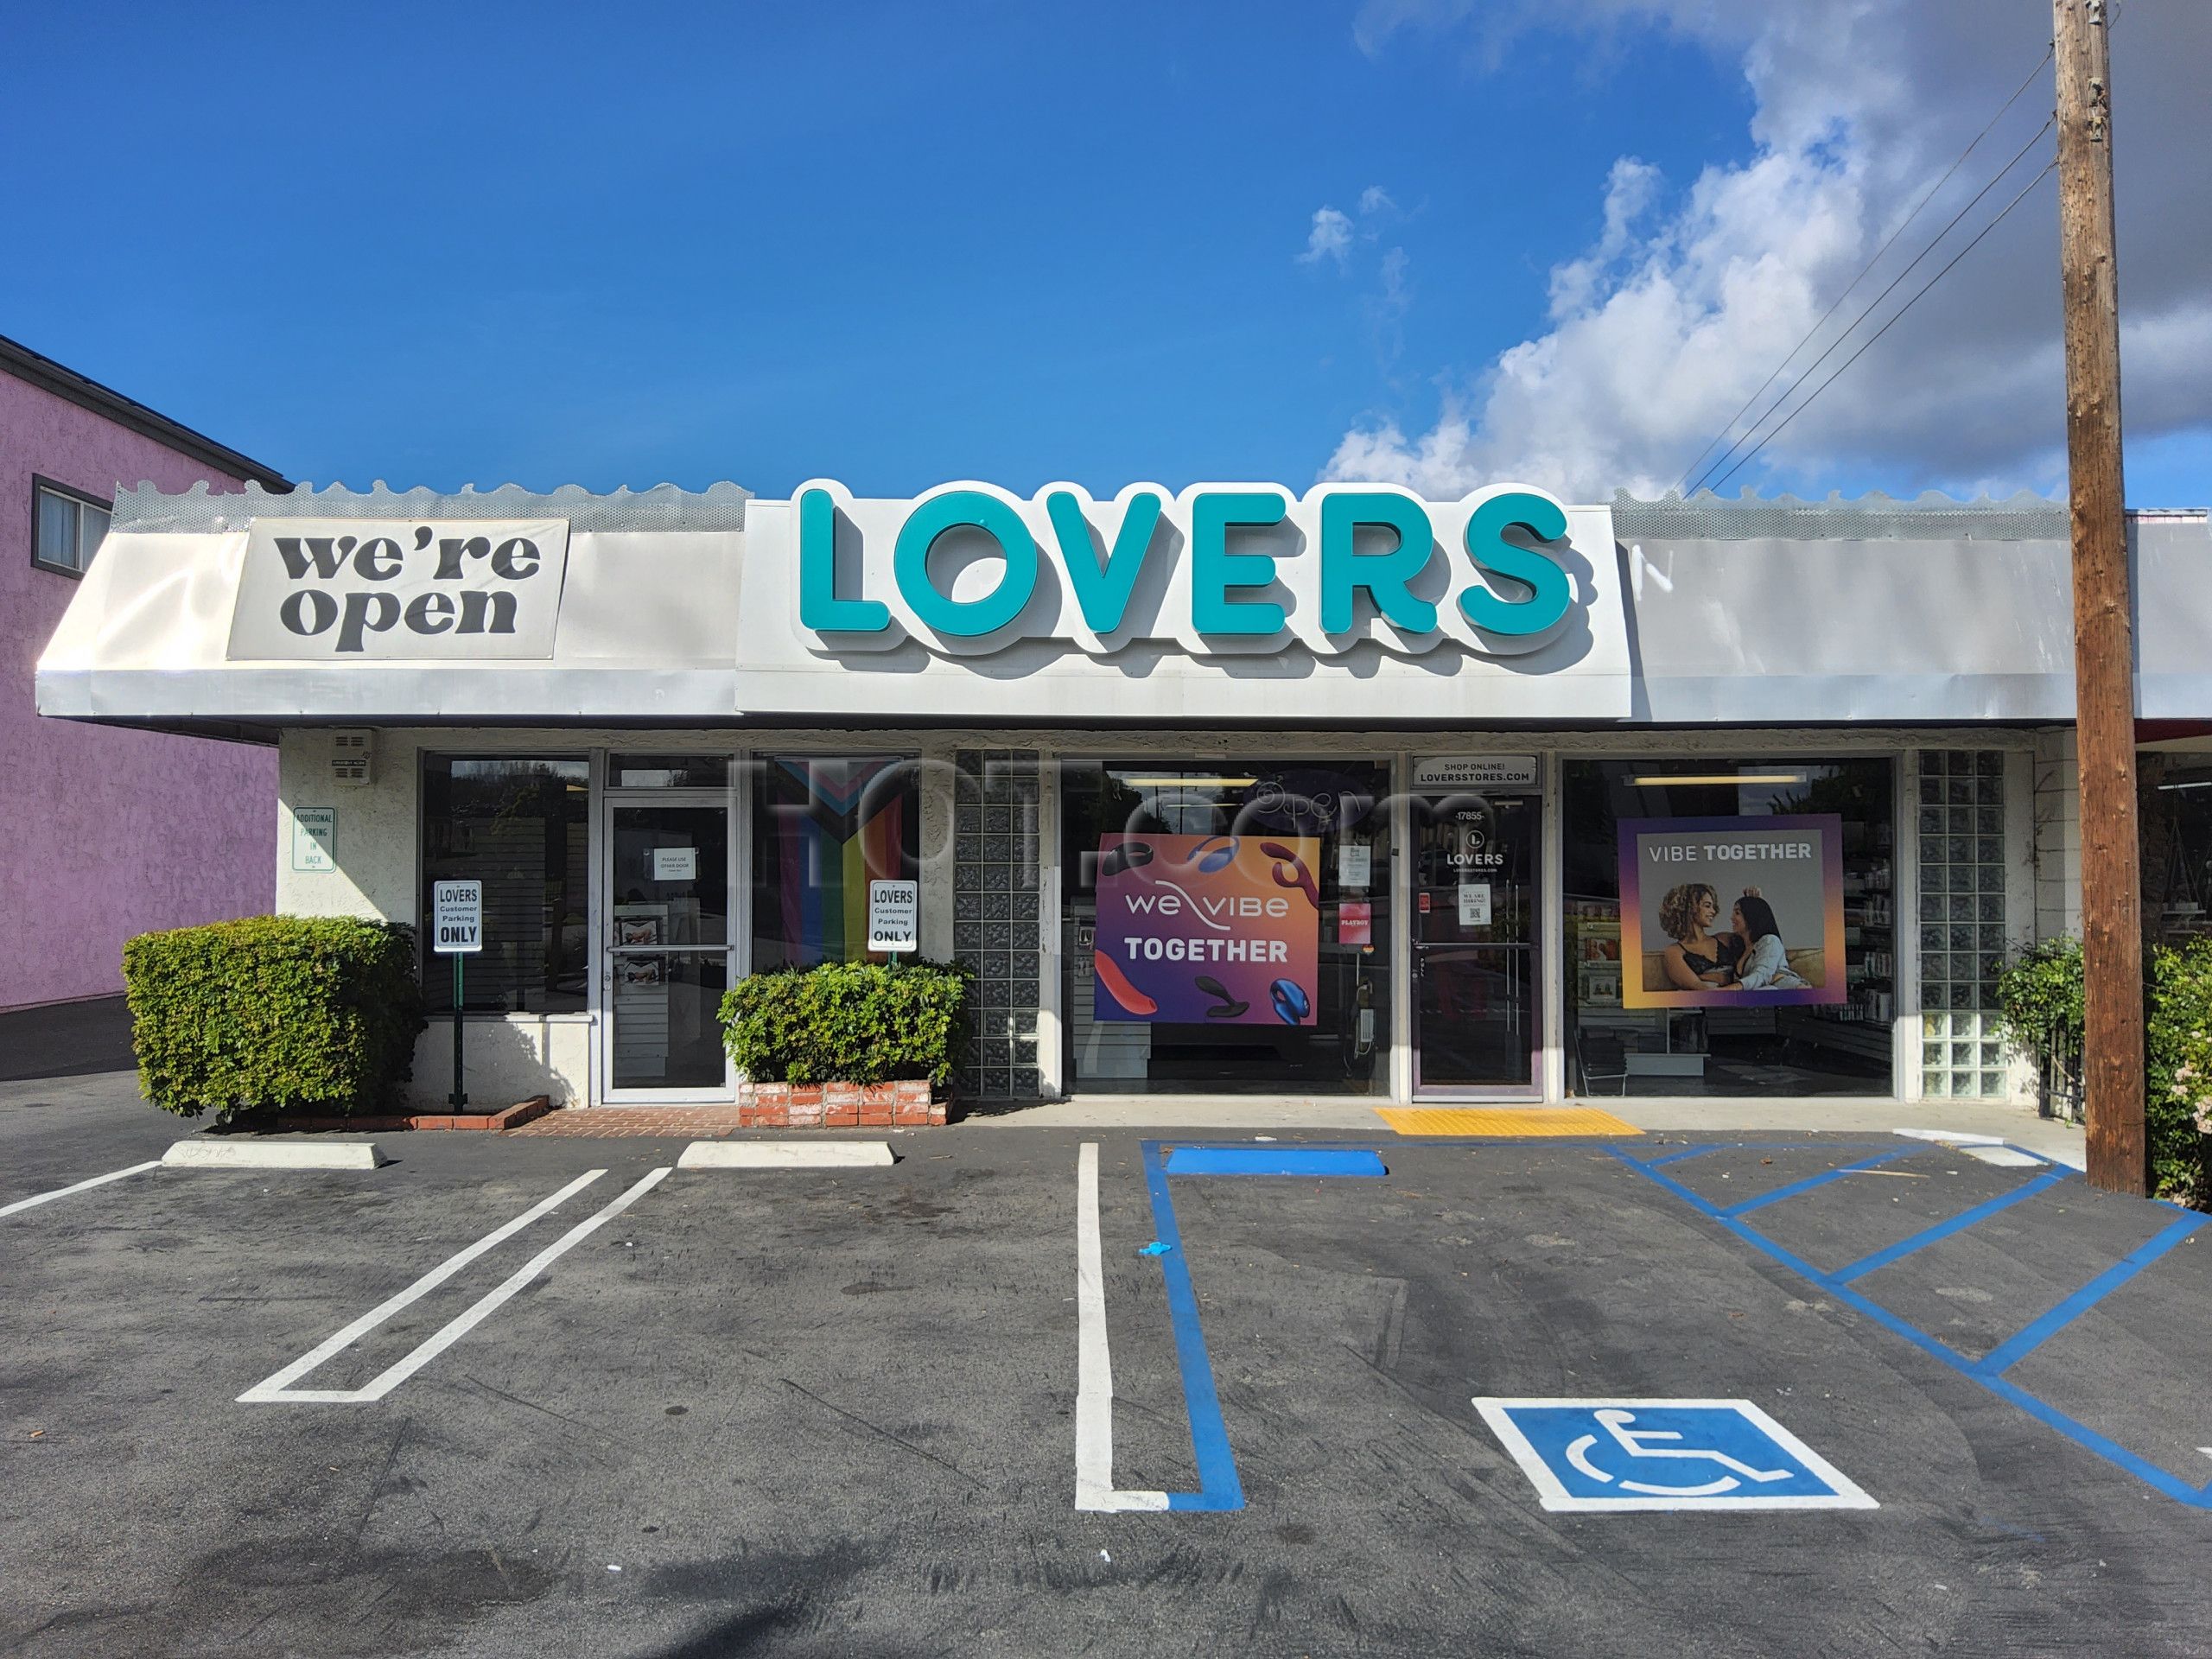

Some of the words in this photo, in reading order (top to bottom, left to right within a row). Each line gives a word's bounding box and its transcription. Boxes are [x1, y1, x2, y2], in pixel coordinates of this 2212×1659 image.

[273, 525, 541, 581] we're
[799, 488, 1571, 637] LOVERS
[279, 588, 518, 652] open
[1420, 772, 1529, 782] LOVERSSTORES.COM
[296, 814, 333, 823] ADDITIONAL
[300, 828, 327, 836] PARKING
[310, 842, 317, 850] IN
[1649, 846, 1698, 861] VIBE
[1703, 842, 1812, 861] TOGETHER
[305, 855, 322, 864] BACK
[1446, 854, 1504, 865] LOVERS
[440, 889, 478, 902] LOVERS
[874, 889, 913, 904] LOVERS
[878, 918, 908, 926] Parking
[441, 926, 477, 943] ONLY
[874, 931, 912, 942] ONLY
[1124, 937, 1287, 963] TOGETHER
